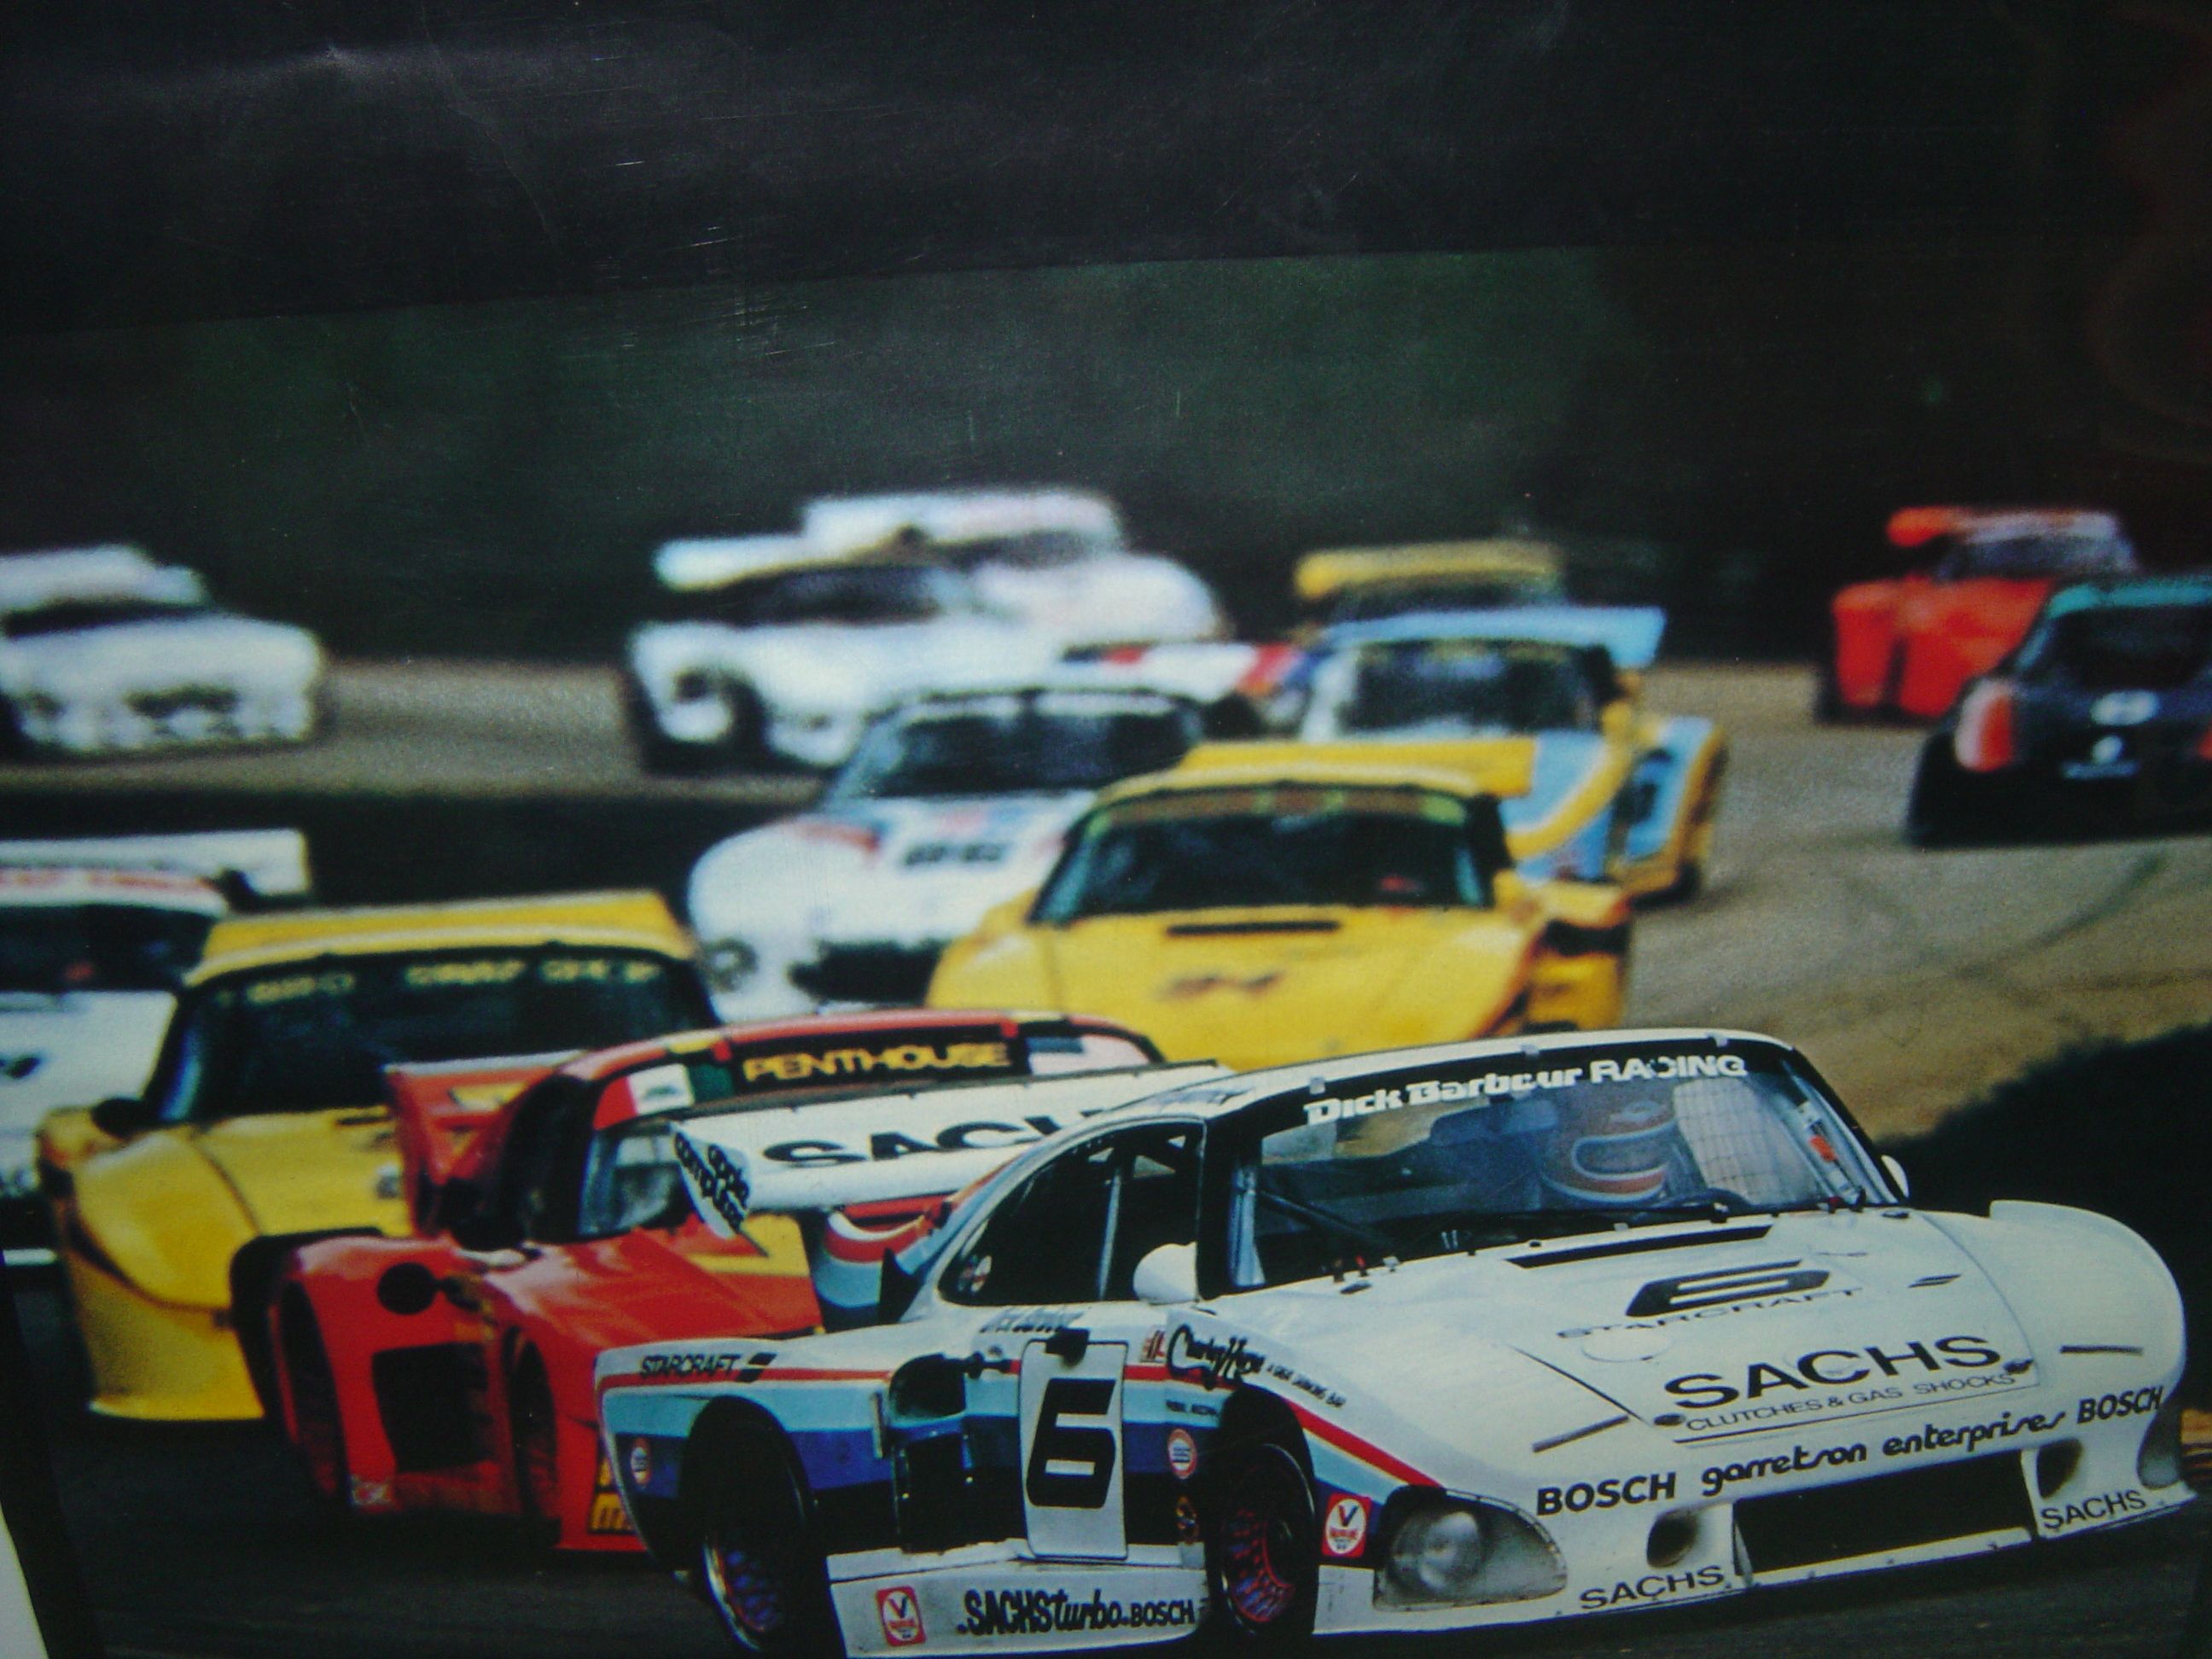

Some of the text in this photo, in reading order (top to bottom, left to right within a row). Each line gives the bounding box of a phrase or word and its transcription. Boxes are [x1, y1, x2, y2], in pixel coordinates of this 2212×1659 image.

[742, 1042, 1012, 1082] PENTHOUSE
[1304, 1087, 1405, 1124] Dick
[1664, 1334, 2000, 1409] SACHS
[1686, 1371, 2017, 1432] CLUTCHES & GAS SHOCKS
[1026, 1379, 1115, 1507] 6
[1536, 1386, 2166, 1516] BOSCH garretson enterprises BOSCH
[2040, 1488, 2146, 1531] SACHS
[1579, 1565, 1726, 1611] SACHS
